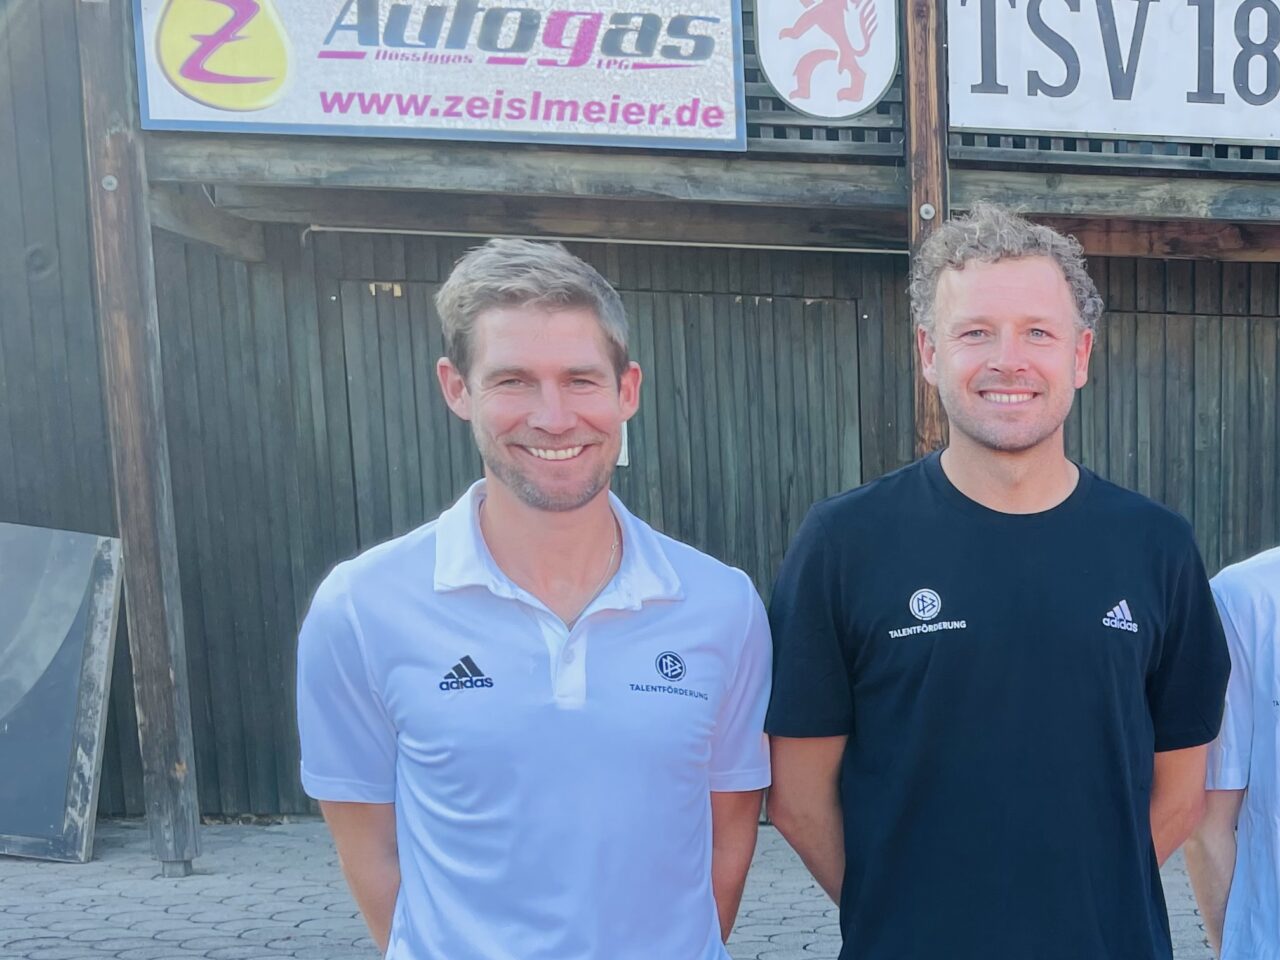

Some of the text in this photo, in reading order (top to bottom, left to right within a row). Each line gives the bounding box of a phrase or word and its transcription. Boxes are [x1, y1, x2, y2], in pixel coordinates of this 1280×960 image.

[323, 0, 720, 67] Autogas
[961, 0, 1160, 100] TSV
[319, 90, 725, 128] www.zeislmeier.de
[889, 620, 967, 639] TALENTFÖRDERUNG
[1102, 616, 1138, 633] adidas
[439, 675, 494, 691] adidas
[630, 684, 709, 701] TALENTFÖRDERUNG
